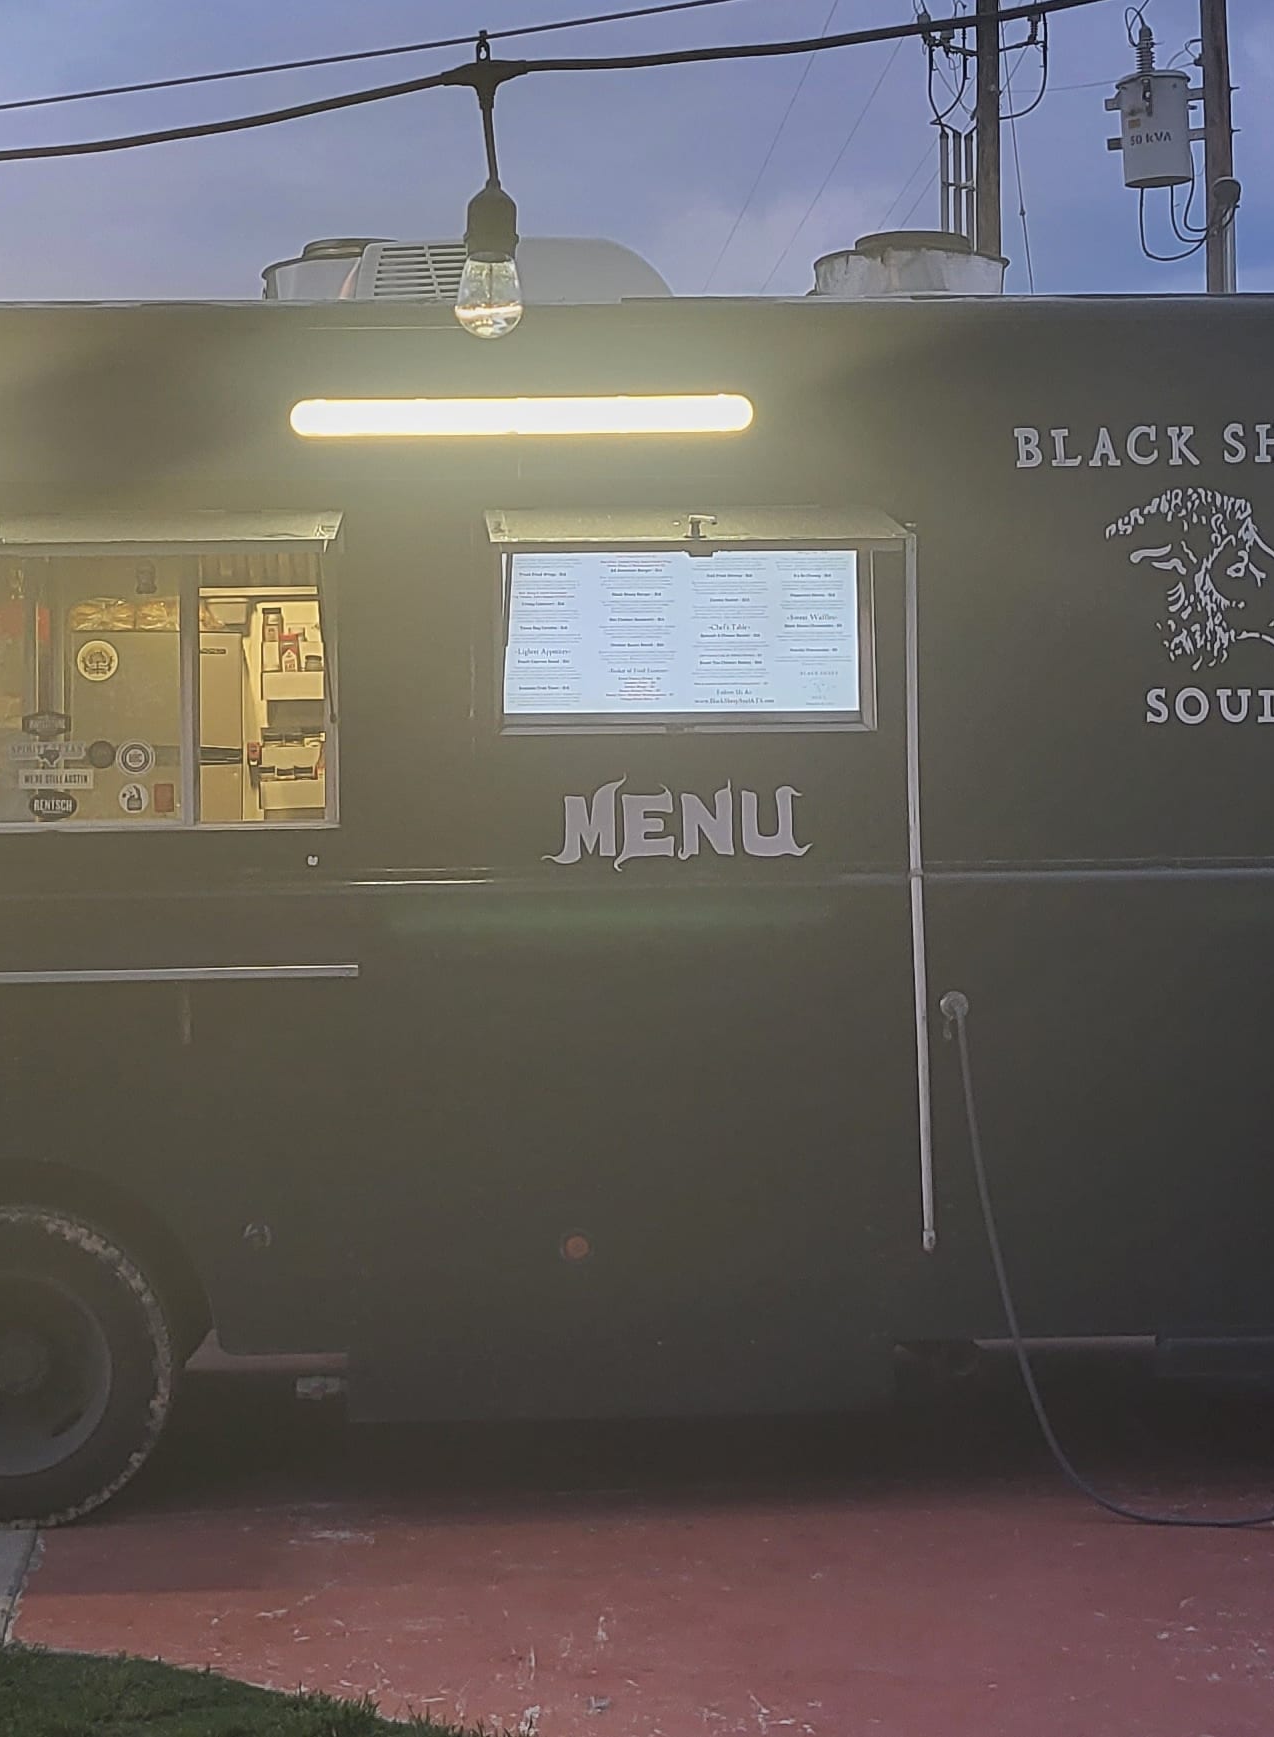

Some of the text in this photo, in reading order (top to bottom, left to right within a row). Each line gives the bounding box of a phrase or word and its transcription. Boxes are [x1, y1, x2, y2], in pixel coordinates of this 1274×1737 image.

[1013, 425, 1200, 468] BLACK
[64, 774, 88, 784] AUSTIN
[33, 799, 73, 812] RENTSCH
[541, 773, 813, 872] MENU
